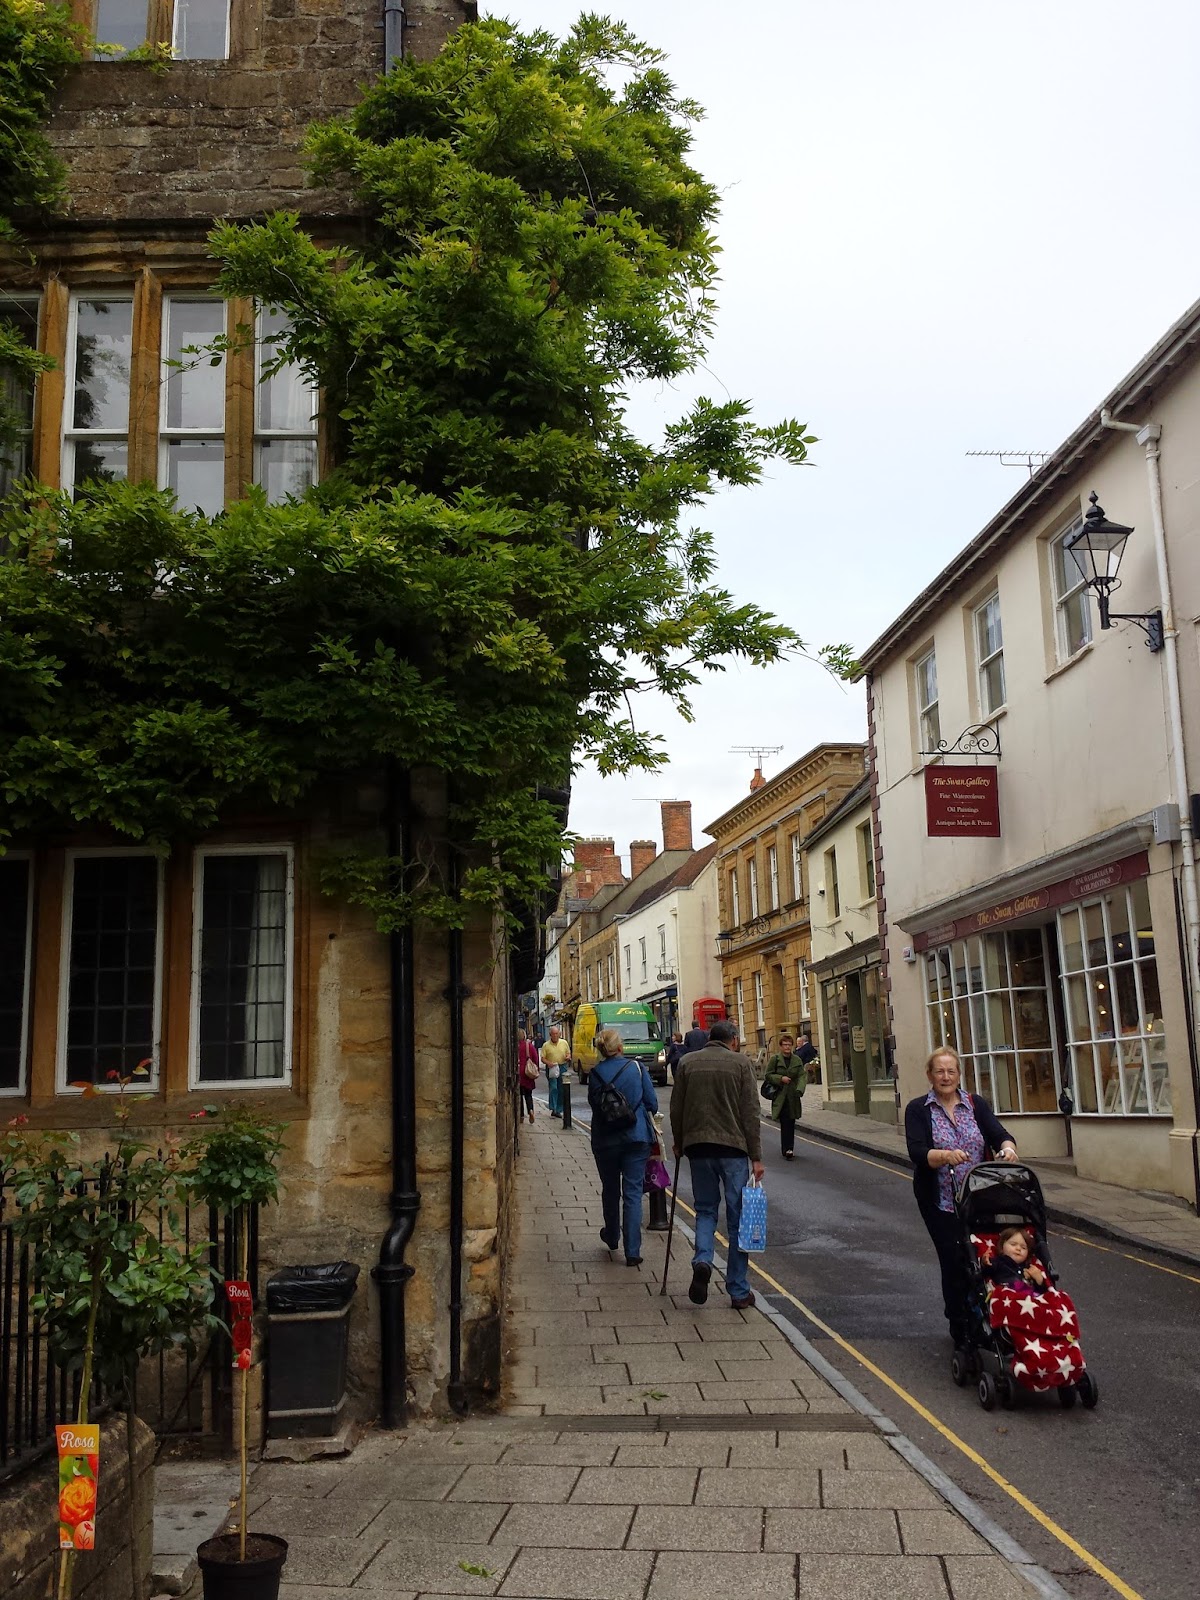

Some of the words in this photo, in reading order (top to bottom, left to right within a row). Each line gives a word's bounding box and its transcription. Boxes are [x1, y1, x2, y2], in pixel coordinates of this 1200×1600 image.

[932, 777, 946, 786] The
[946, 777, 966, 786] Swan
[966, 776, 990, 788] Gallery
[976, 911, 991, 925] The
[992, 906, 1013, 921] Swan
[1014, 895, 1040, 916] Gallery
[228, 1285, 249, 1297] Rosa
[60, 1431, 95, 1448] Rosa
